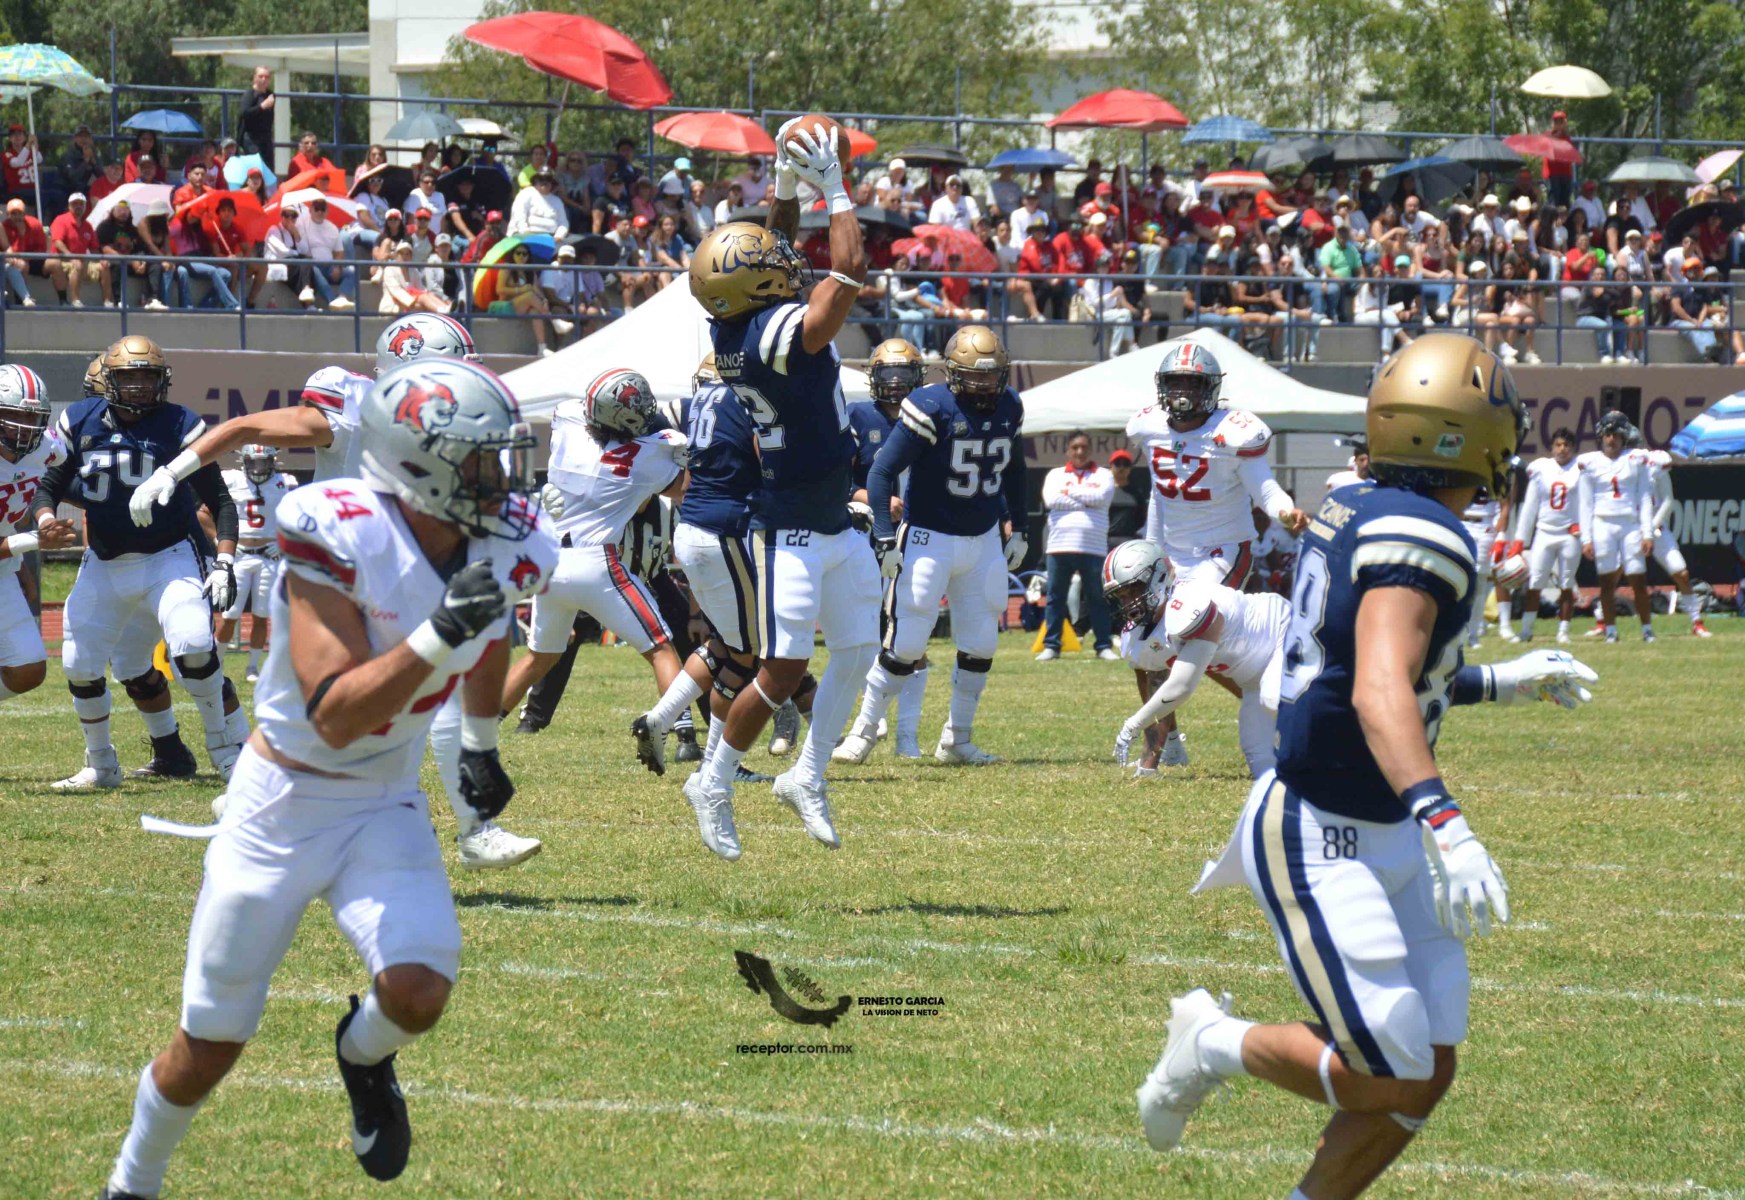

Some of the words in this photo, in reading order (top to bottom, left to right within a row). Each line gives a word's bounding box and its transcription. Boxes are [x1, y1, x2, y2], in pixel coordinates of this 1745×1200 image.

[600, 442, 642, 478] 4
[947, 438, 1012, 499] 53
[1152, 446, 1212, 501] 52
[1550, 481, 1567, 510] 0
[1610, 476, 1622, 499] 1
[246, 499, 266, 529] 5
[786, 529, 812, 547] 22
[911, 530, 931, 546] 53
[1322, 825, 1358, 860] 88
